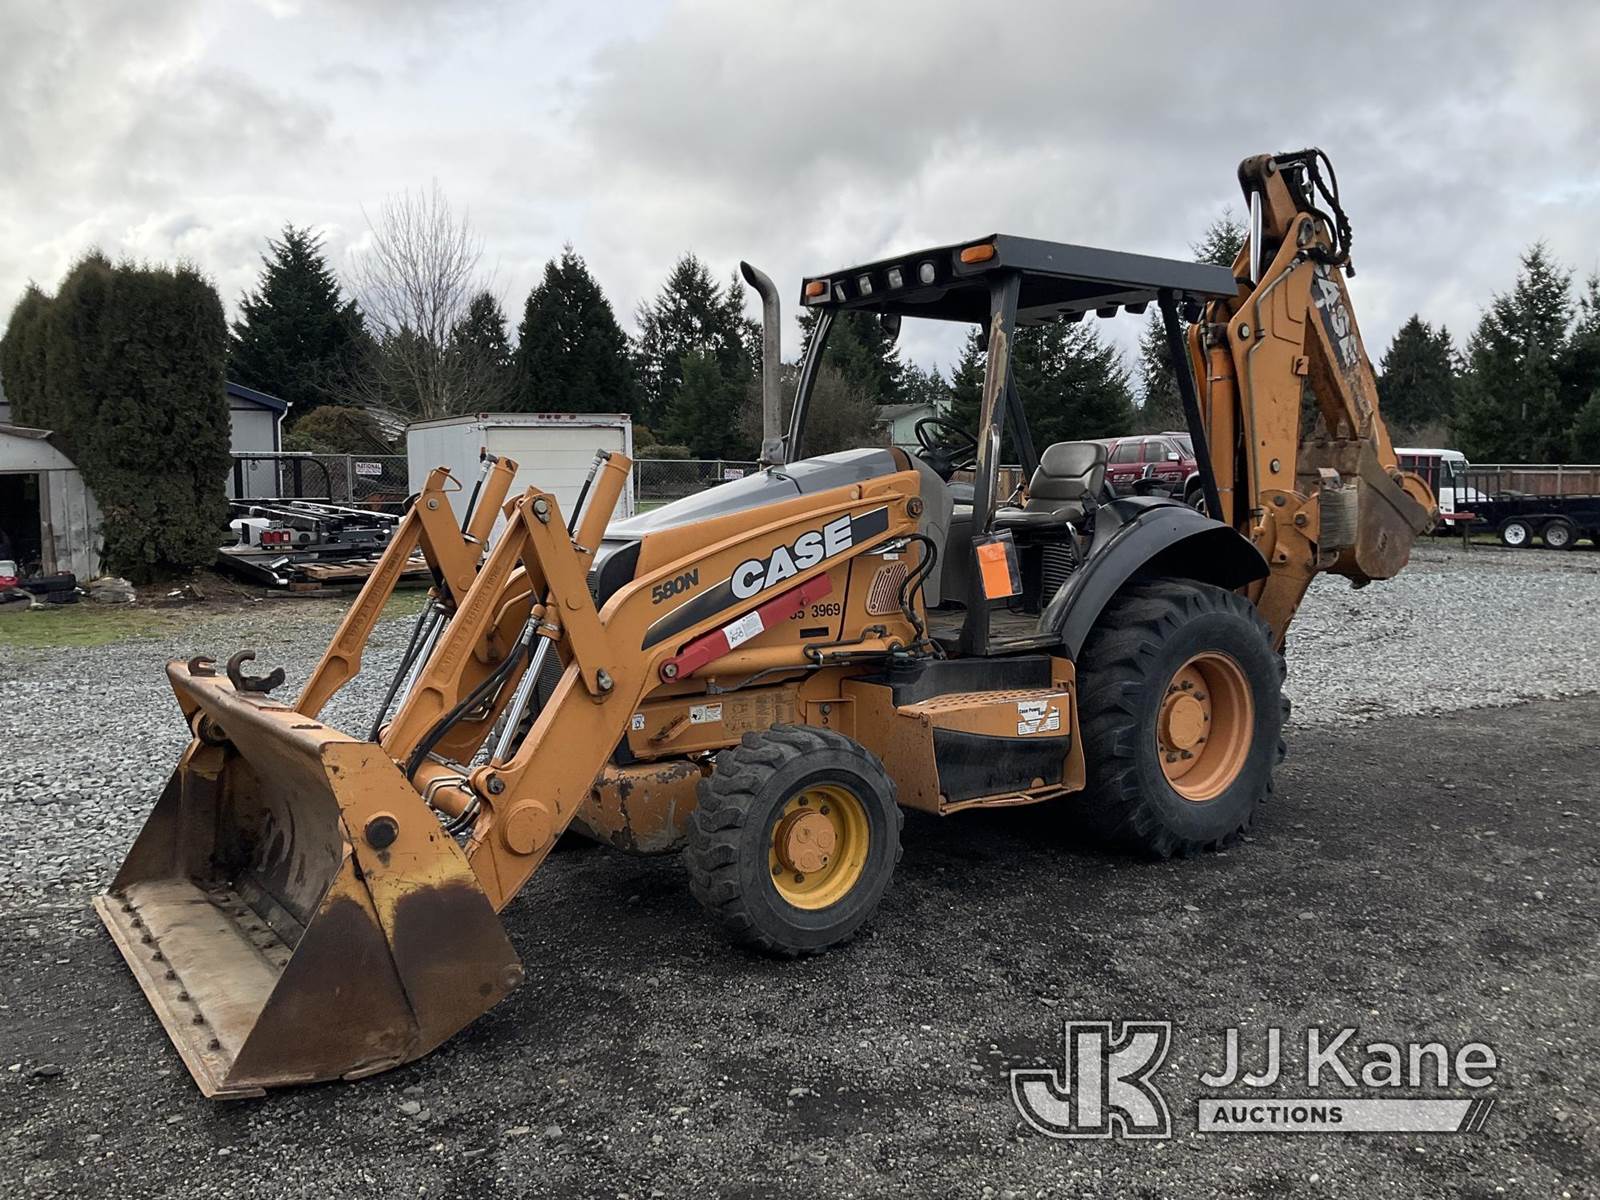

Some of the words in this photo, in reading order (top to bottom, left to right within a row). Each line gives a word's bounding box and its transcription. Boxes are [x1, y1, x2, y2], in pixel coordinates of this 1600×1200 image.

[730, 514, 853, 600] CASE
[652, 567, 699, 605] 580N
[811, 603, 841, 618] 3969
